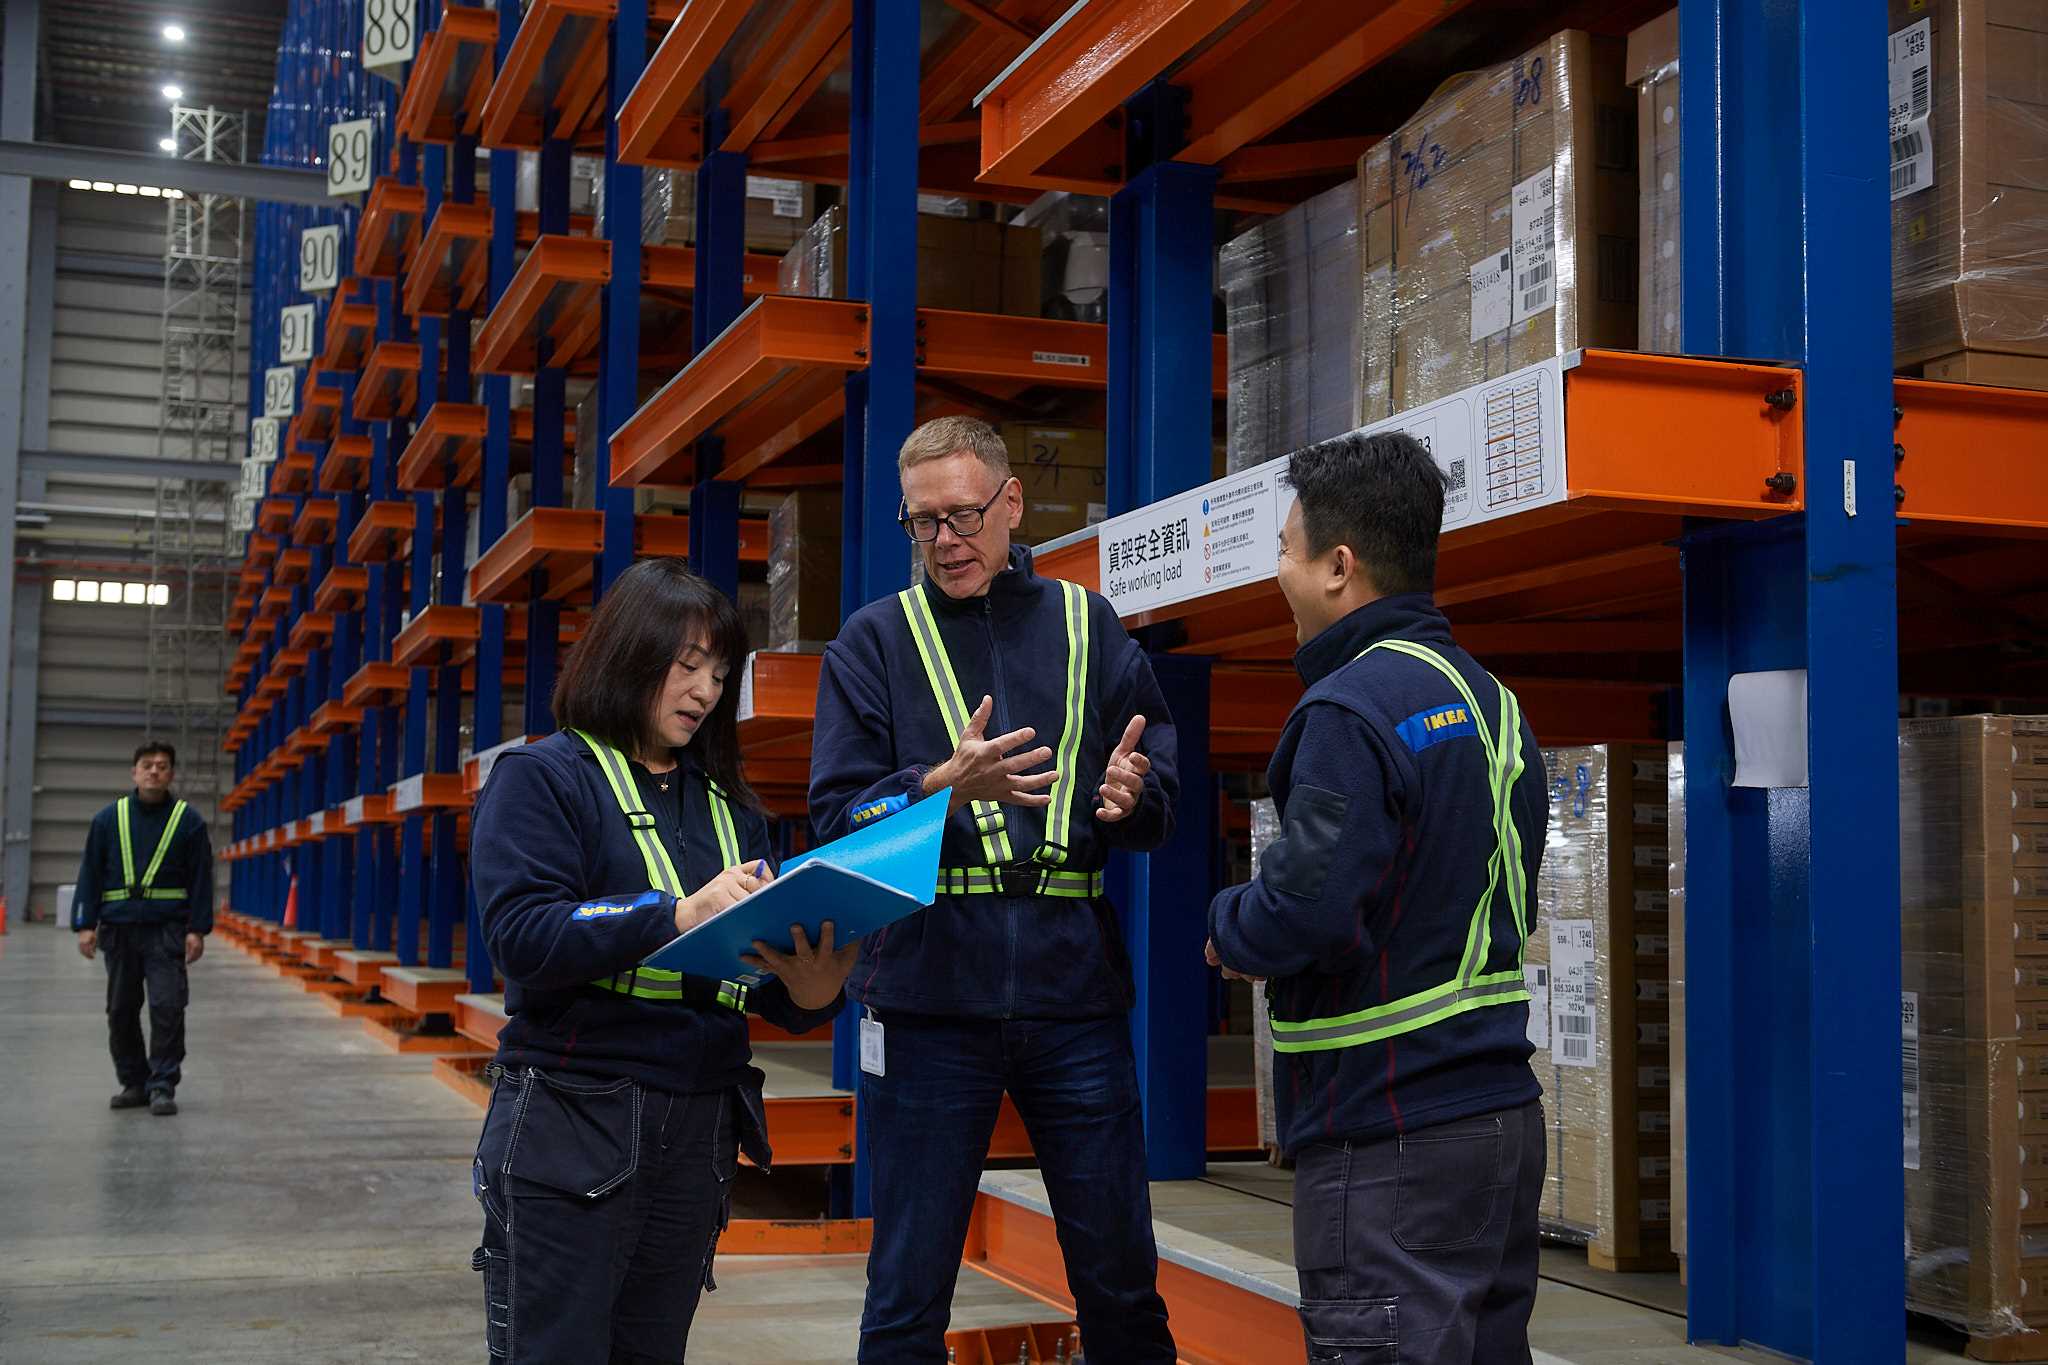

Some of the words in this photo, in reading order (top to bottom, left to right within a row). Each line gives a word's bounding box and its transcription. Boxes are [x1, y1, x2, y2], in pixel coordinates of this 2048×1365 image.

[366, 0, 411, 56] 88
[1905, 30, 1925, 49] 1470
[1909, 41, 1925, 57] 835
[329, 129, 369, 186] 89
[302, 233, 336, 283] 90
[281, 313, 310, 355] 91
[266, 372, 291, 411] 92
[253, 421, 276, 457] 93
[1109, 517, 1191, 574] 貨架安全資訊
[1109, 576, 1127, 598] Safe
[1128, 569, 1161, 592] working
[1163, 559, 1182, 582] load
[1423, 708, 1468, 731] IKEA
[1578, 930, 1592, 939] 1240
[1581, 939, 1592, 949] 745
